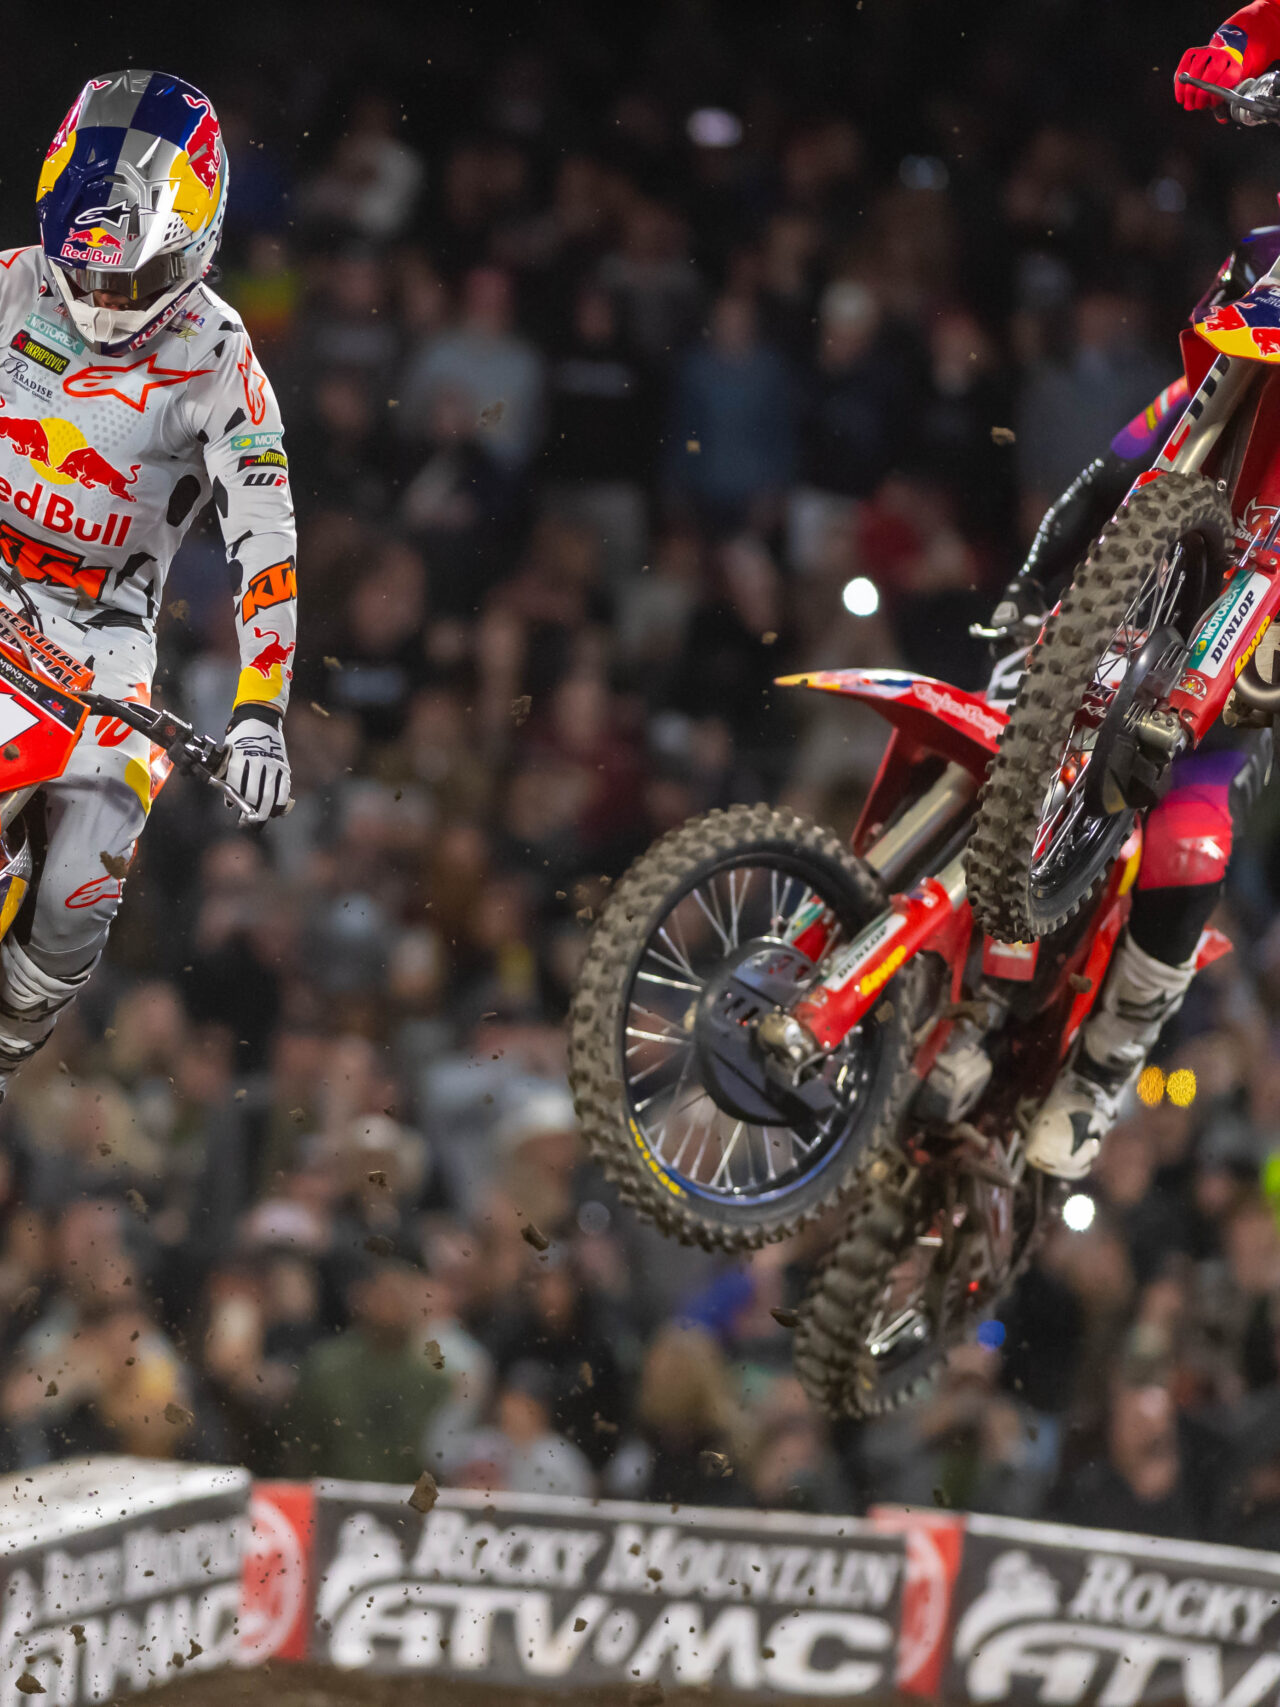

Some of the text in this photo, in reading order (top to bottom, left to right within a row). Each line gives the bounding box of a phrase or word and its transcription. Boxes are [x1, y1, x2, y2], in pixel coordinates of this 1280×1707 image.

[60, 243, 122, 266] Red Bull
[30, 316, 80, 352] MOTOREX
[243, 472, 288, 487] WP
[44, 489, 132, 548] Bull
[1210, 589, 1256, 665] DUNLOP
[412, 1509, 903, 1610] ROCKY MOUNTAIN
[1067, 1552, 1280, 1646] ROCKY
